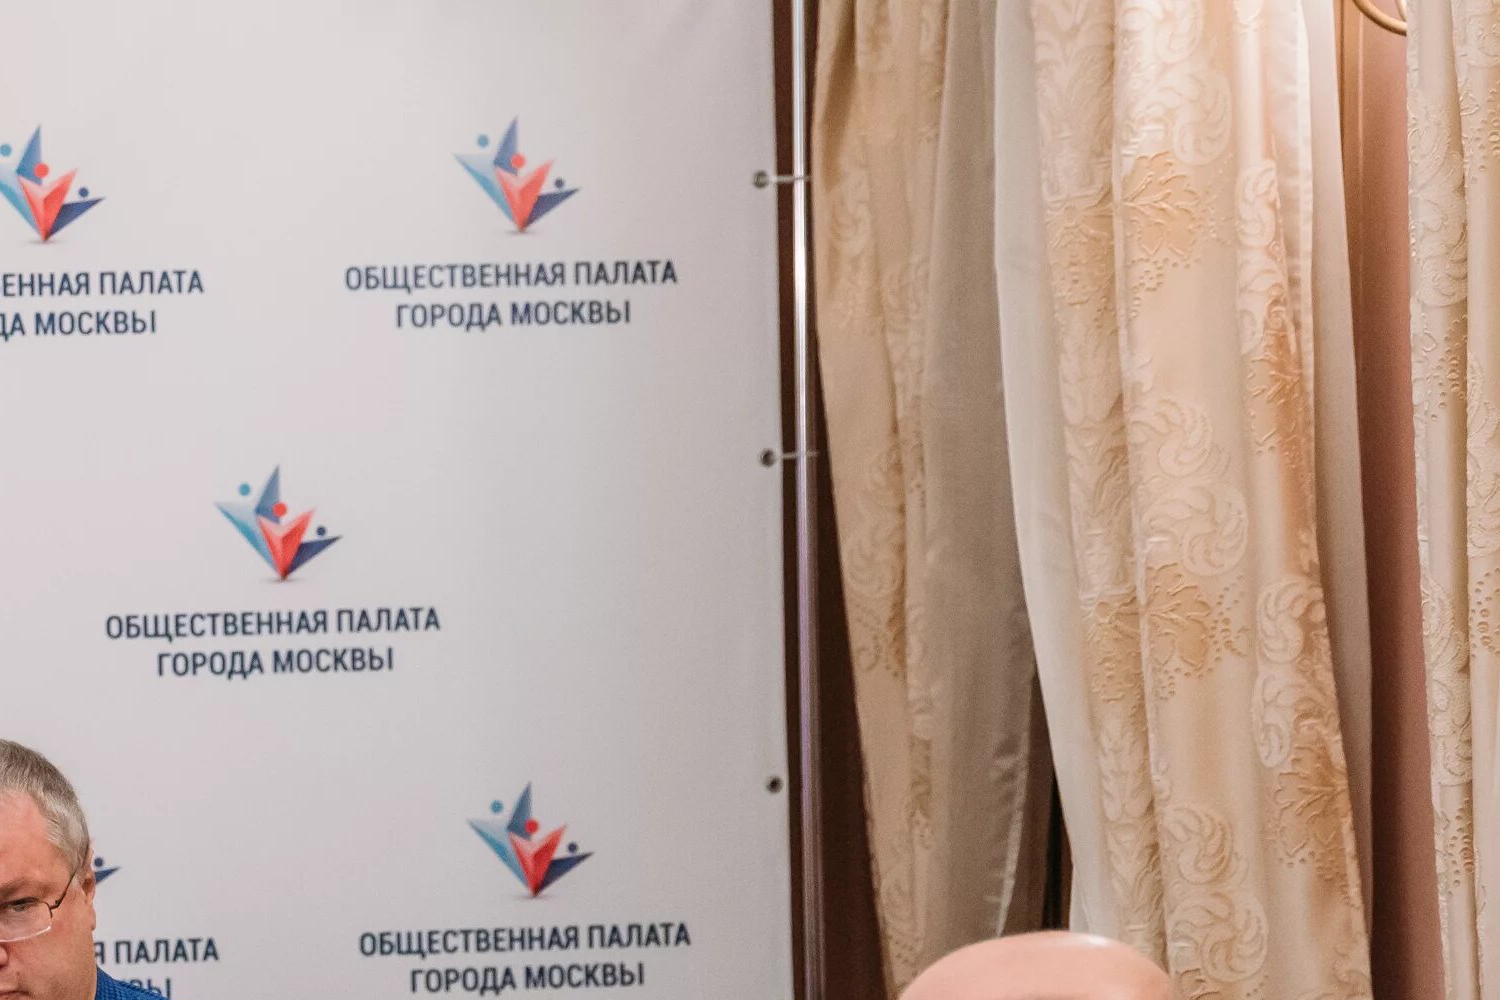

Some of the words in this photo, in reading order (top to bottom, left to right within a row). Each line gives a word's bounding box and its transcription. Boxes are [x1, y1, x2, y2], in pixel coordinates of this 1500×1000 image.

[99, 270, 204, 295] ПАЛАТА
[345, 261, 566, 294] ОБЩЕСТВЕННАЯ
[574, 260, 678, 285] ПАЛАТА
[34, 310, 156, 336] МОСКВЫ
[396, 302, 503, 333] ГОРОДА
[511, 300, 631, 326] МОСКВЫ
[106, 610, 328, 643] ОБЩЕСТВЕННАЯ
[337, 607, 441, 633] ПАЛАТА
[157, 650, 265, 680] ГОРОДА
[273, 647, 393, 674] МОСКВЫ
[114, 937, 219, 964] ПАЛАТА
[359, 925, 580, 960] ОБЩЕСТВЕННАЯ
[587, 922, 691, 949] ПАЛАТА
[410, 966, 517, 997] ГОРОДА
[524, 962, 645, 990] МОСКВЫ
